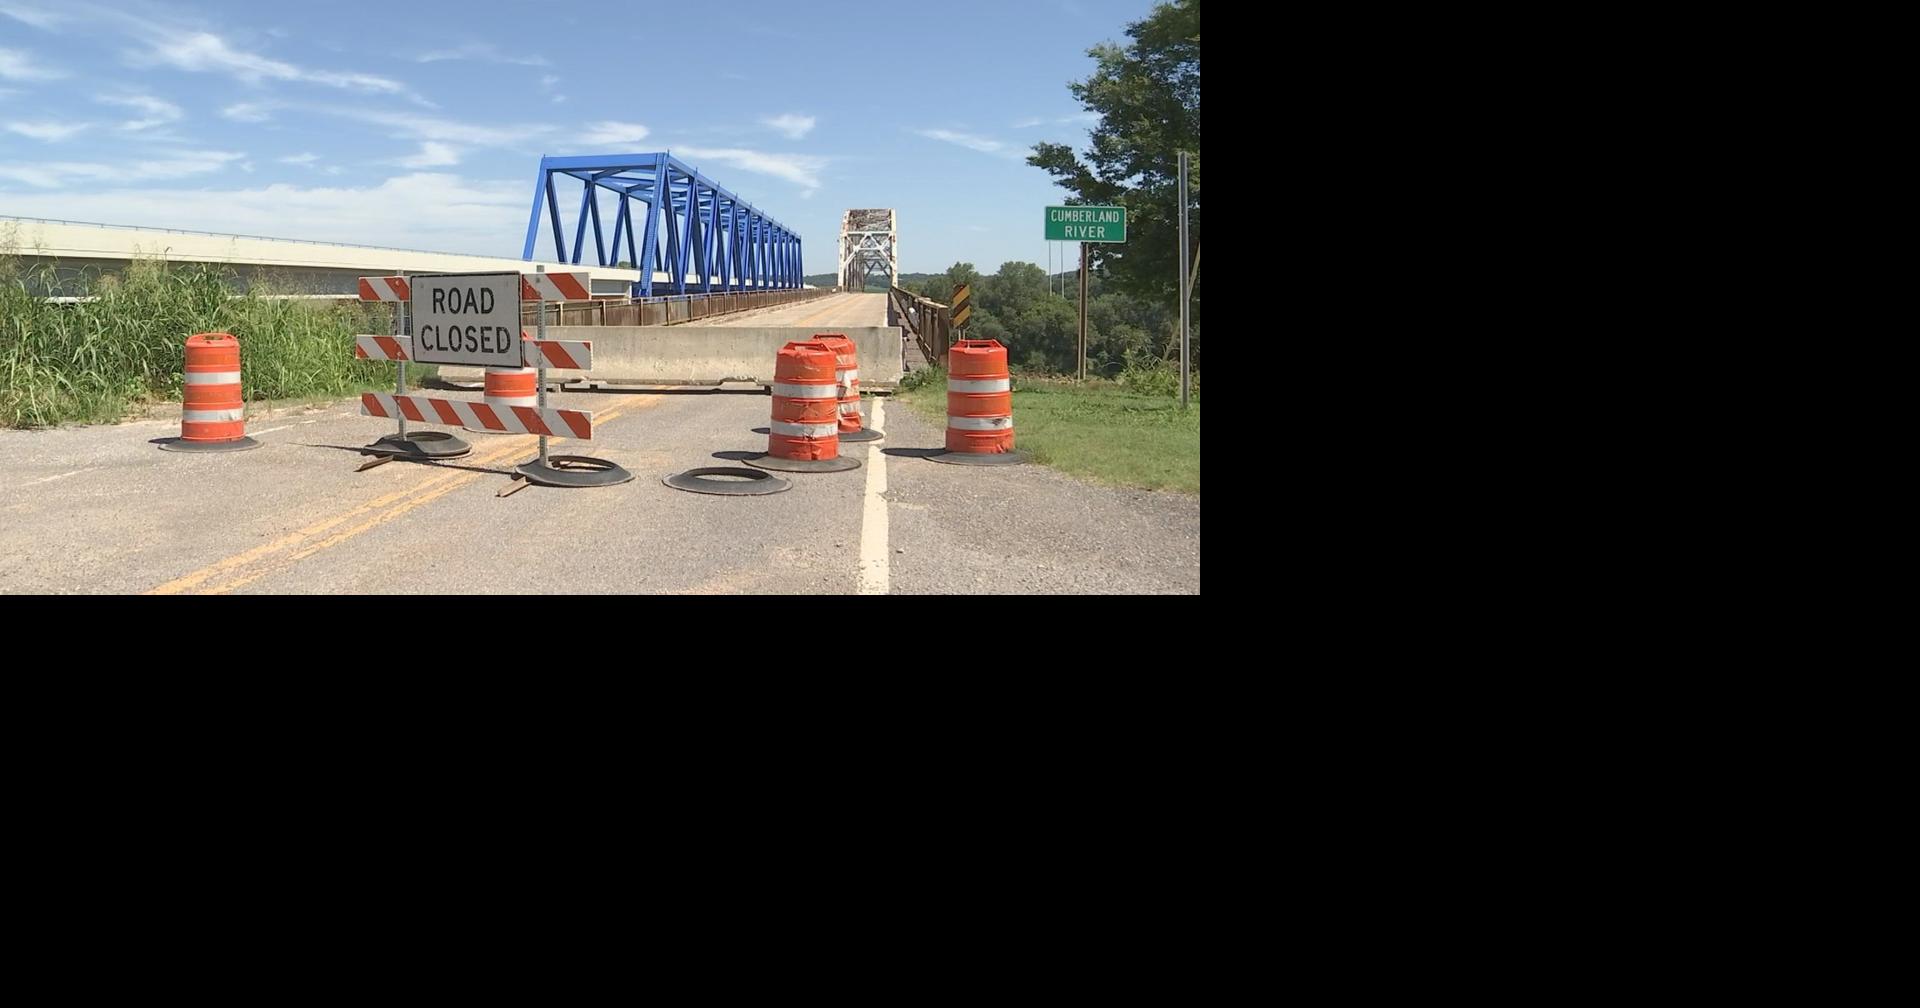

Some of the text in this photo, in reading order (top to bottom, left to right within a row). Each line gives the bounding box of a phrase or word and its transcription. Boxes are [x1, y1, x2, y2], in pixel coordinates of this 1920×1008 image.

[1051, 210, 1119, 223] CUMBERLAND
[1065, 226, 1105, 238] RIVER
[433, 287, 494, 314] ROAD
[421, 325, 511, 354] CLOSED
